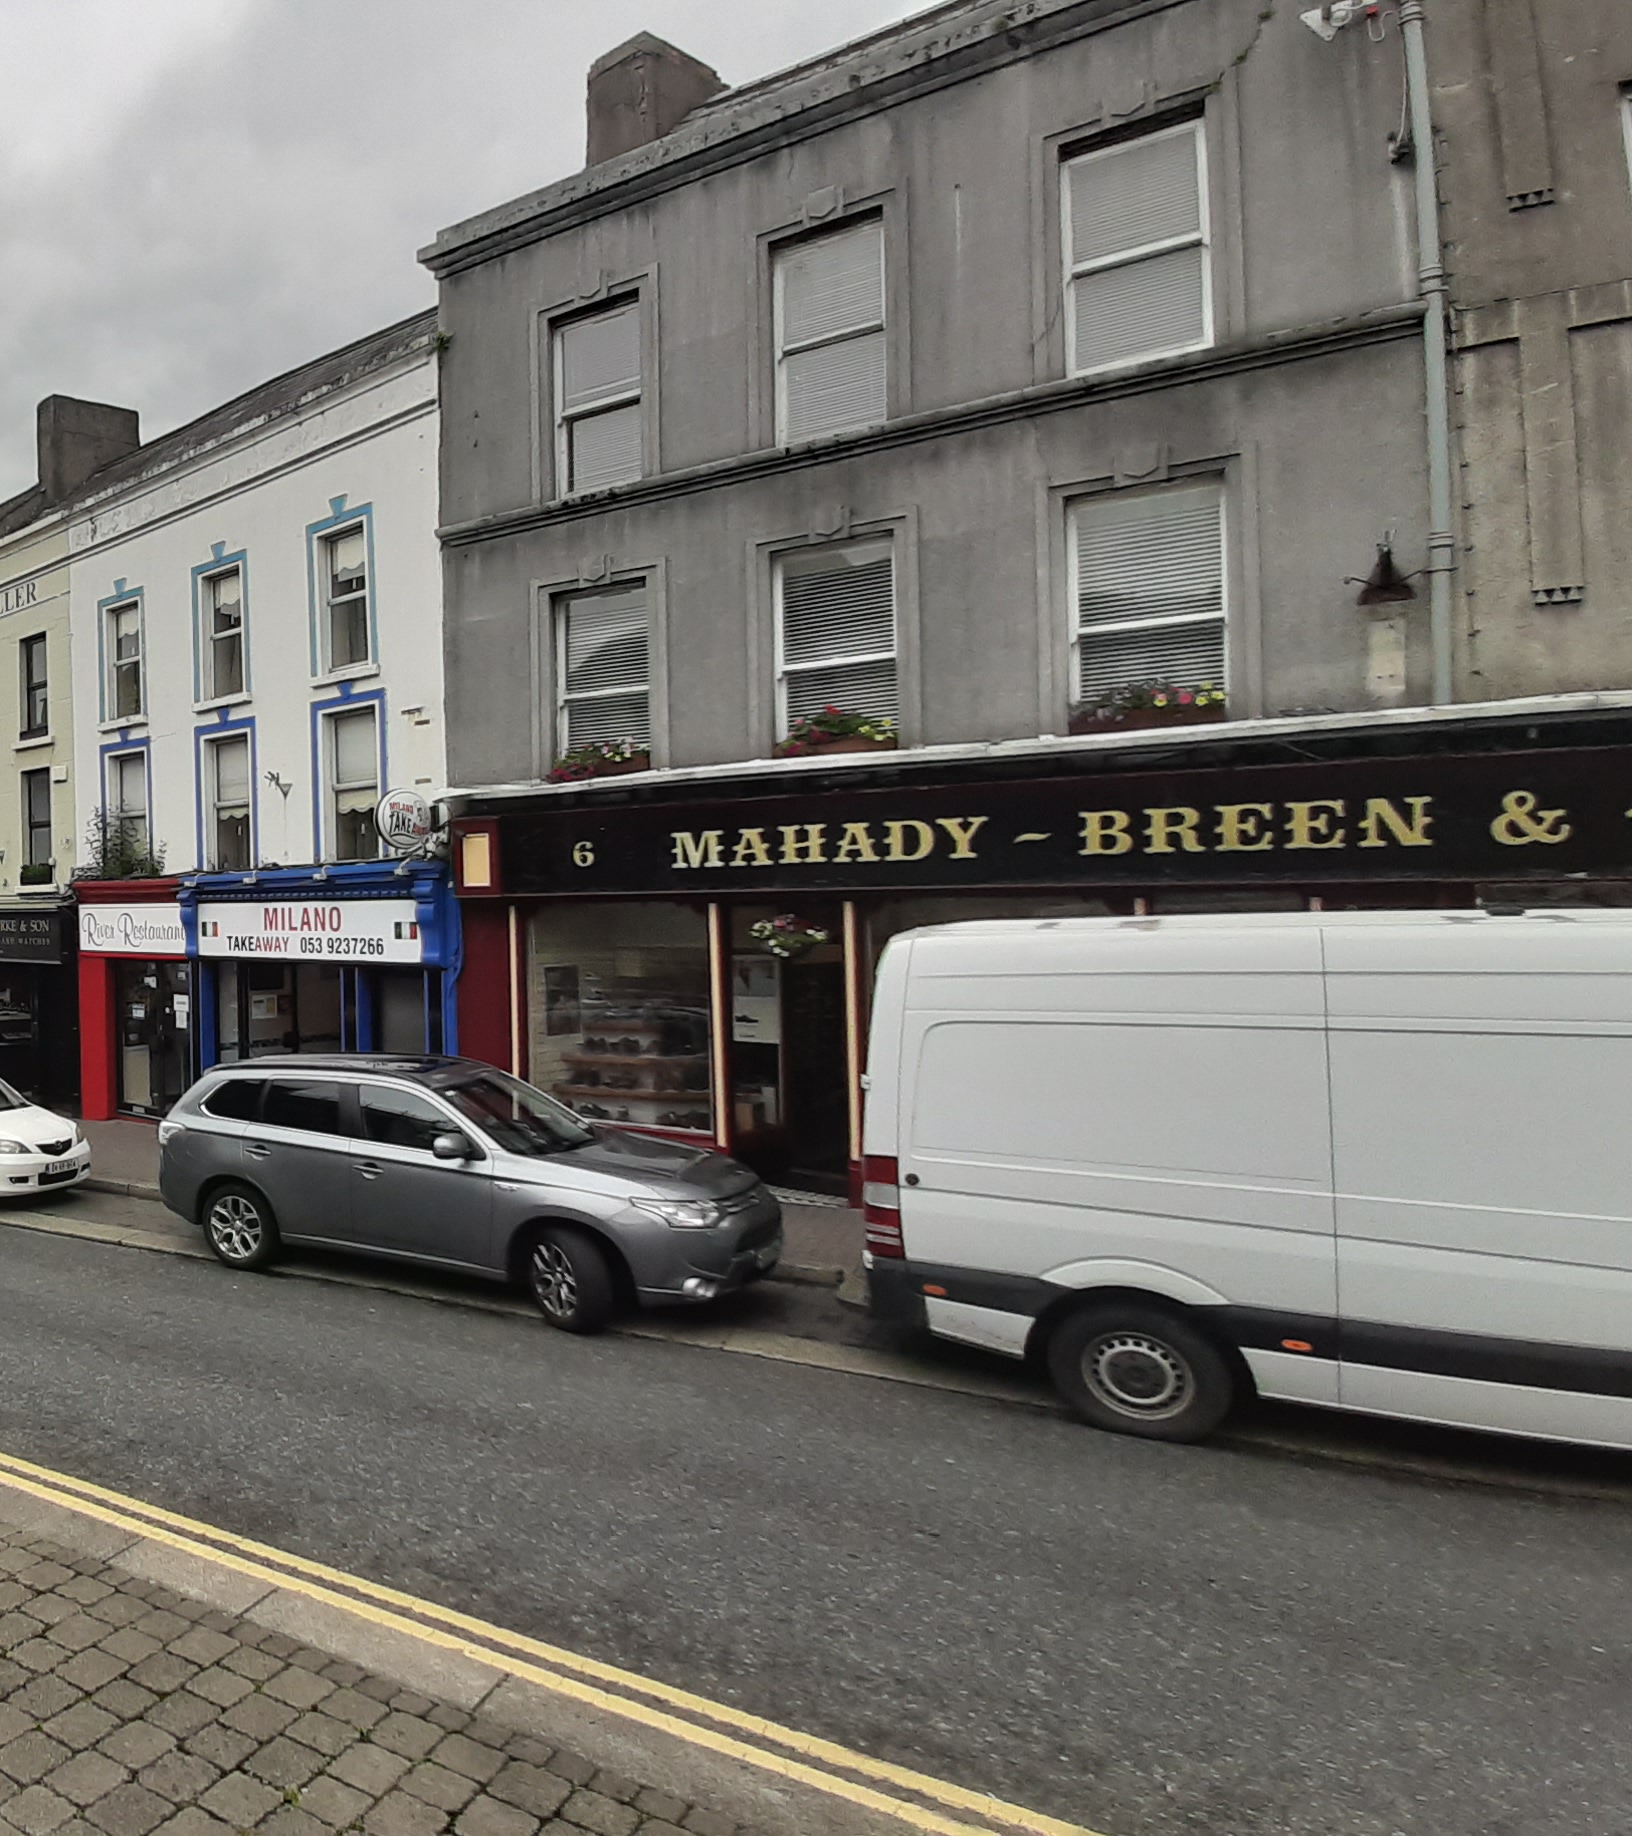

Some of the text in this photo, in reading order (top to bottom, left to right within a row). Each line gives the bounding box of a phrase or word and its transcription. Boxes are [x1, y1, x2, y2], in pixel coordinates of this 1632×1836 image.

[572, 841, 596, 868] 6
[670, 816, 989, 869] MAHADY
[1077, 796, 1433, 856] BREEN
[1489, 790, 1572, 845] &
[19, 920, 27, 932] &
[30, 920, 49, 932] SON
[82, 912, 115, 947] River
[263, 906, 342, 933] MILANO
[226, 935, 385, 955] TAKEAWAY 053 9237266
